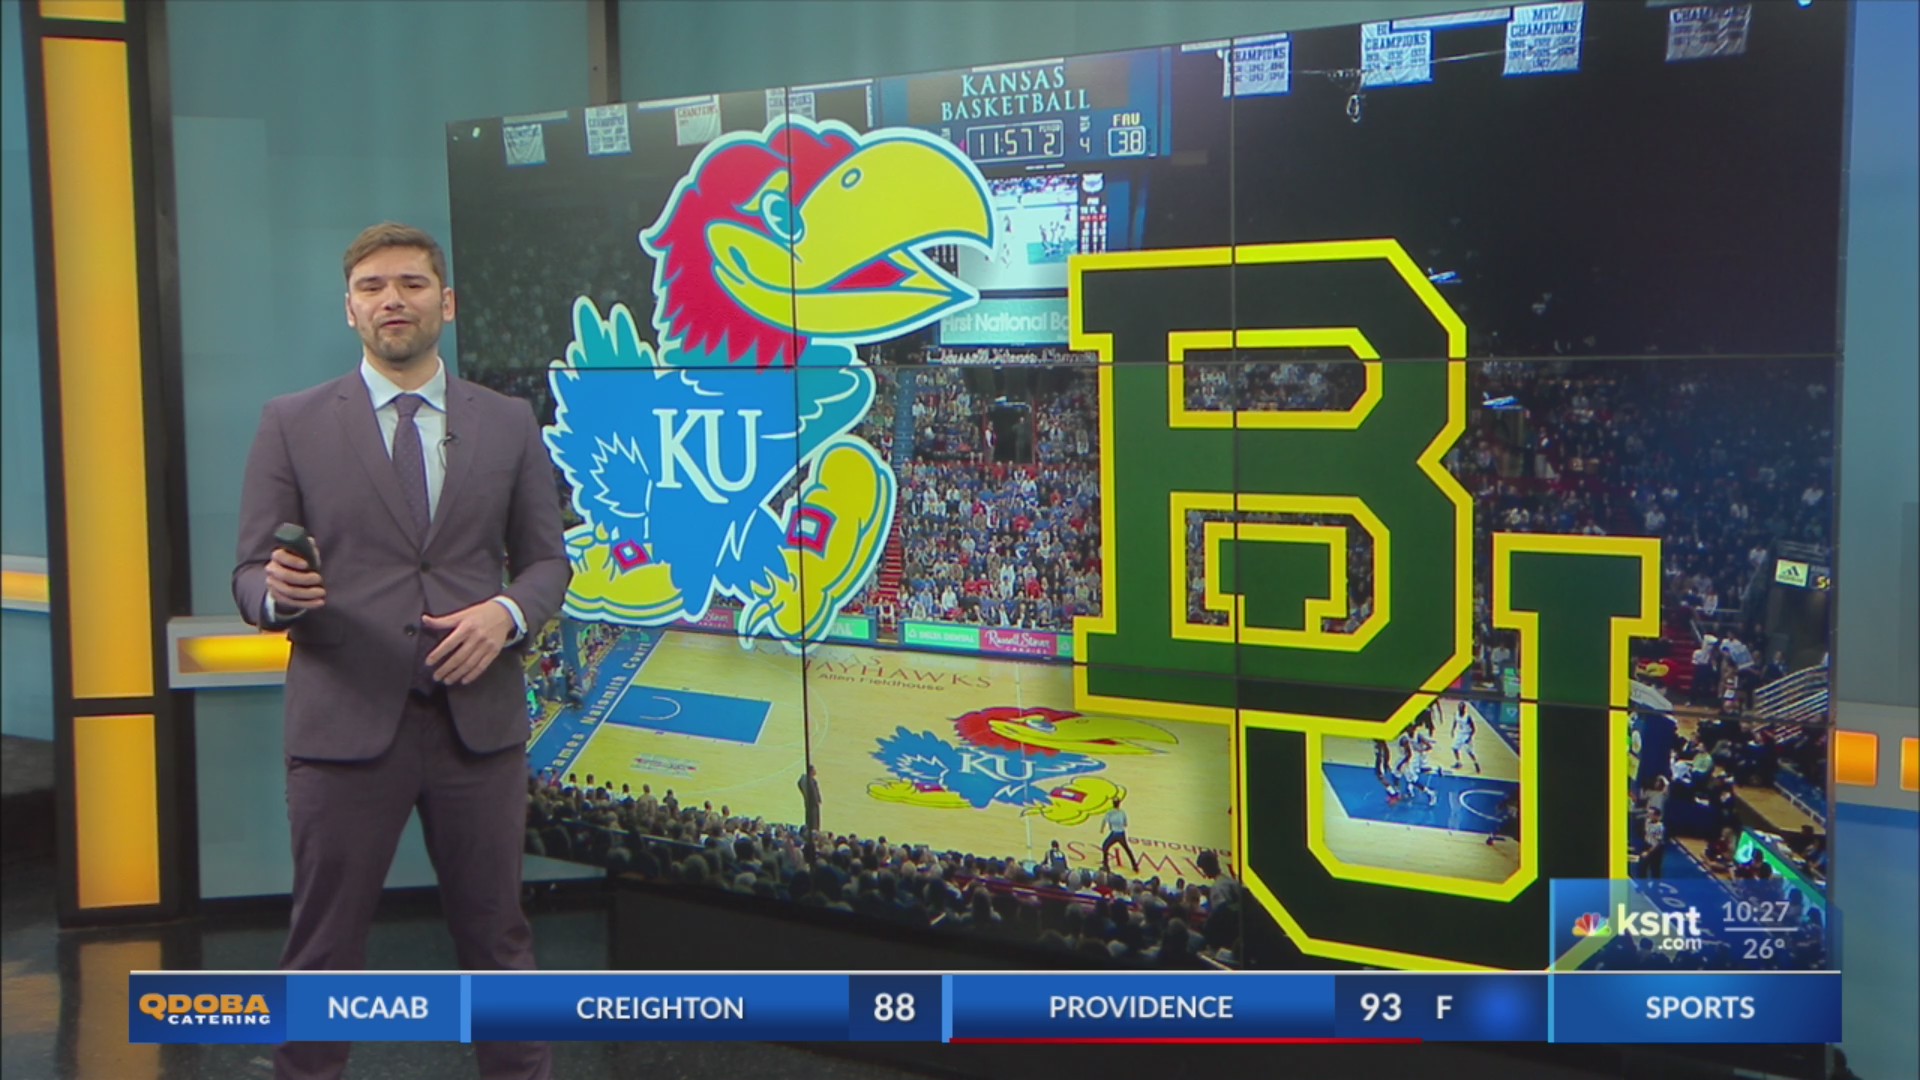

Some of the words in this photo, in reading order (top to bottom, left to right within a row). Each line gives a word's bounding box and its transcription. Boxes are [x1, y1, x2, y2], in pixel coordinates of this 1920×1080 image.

[1511, 20, 1577, 37] CHAMPIONS
[1365, 33, 1427, 50] CHAMPIONS
[961, 66, 1065, 97] KANSAS
[941, 89, 1090, 121] BASKETBALL
[1113, 113, 1140, 127] FAU
[1044, 133, 1055, 155] 2
[1080, 137, 1090, 153] 4
[1118, 130, 1141, 153] 38
[976, 309, 1047, 333] National
[1051, 310, 1069, 331] Ba
[652, 408, 763, 504] KU
[818, 673, 855, 683] Allen
[860, 677, 945, 691] Fieldhouse
[958, 752, 1036, 782] KU
